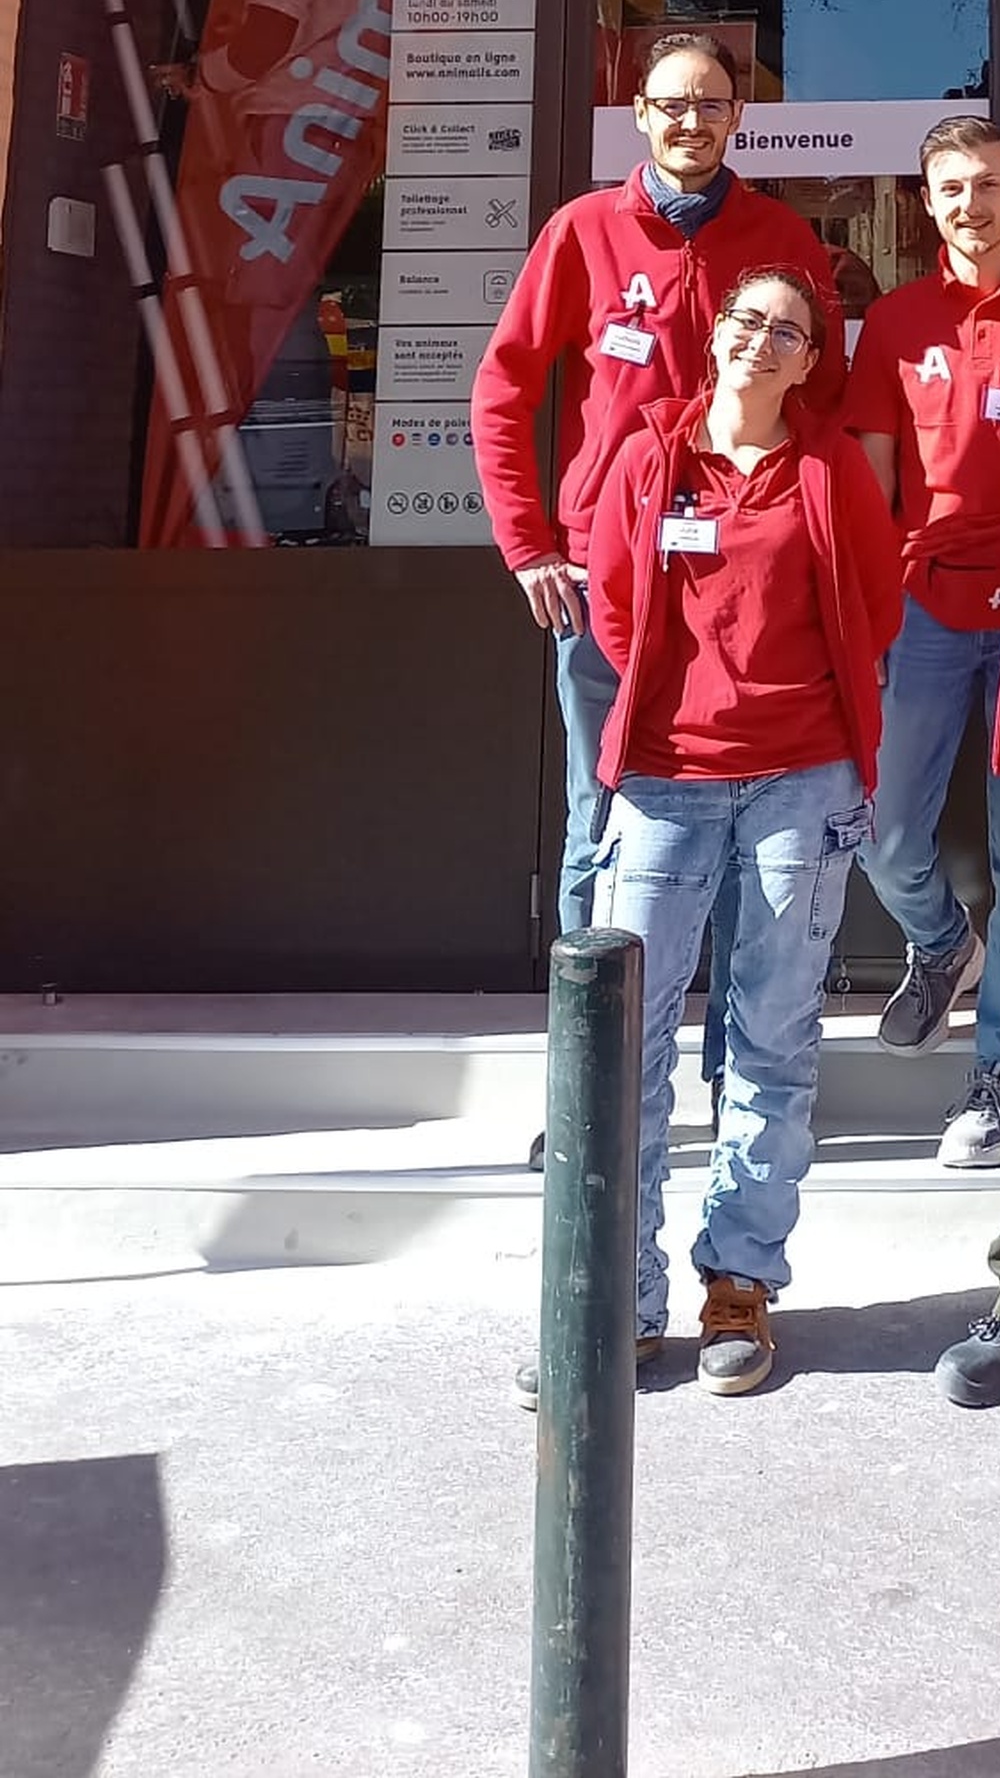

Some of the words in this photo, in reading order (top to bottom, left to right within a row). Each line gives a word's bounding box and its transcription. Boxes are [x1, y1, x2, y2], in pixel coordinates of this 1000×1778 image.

[407, 11, 499, 23] 10h00-19h00
[406, 51, 462, 66] Boutique
[465, 54, 481, 63] en
[484, 51, 517, 66] ligne
[405, 67, 521, 79] www.animalis.com
[402, 124, 428, 134] Click
[440, 124, 476, 133] Collect
[734, 130, 854, 151] Bienvenue
[620, 273, 656, 309] A
[916, 346, 951, 384] A
[428, 418, 441, 428] de
